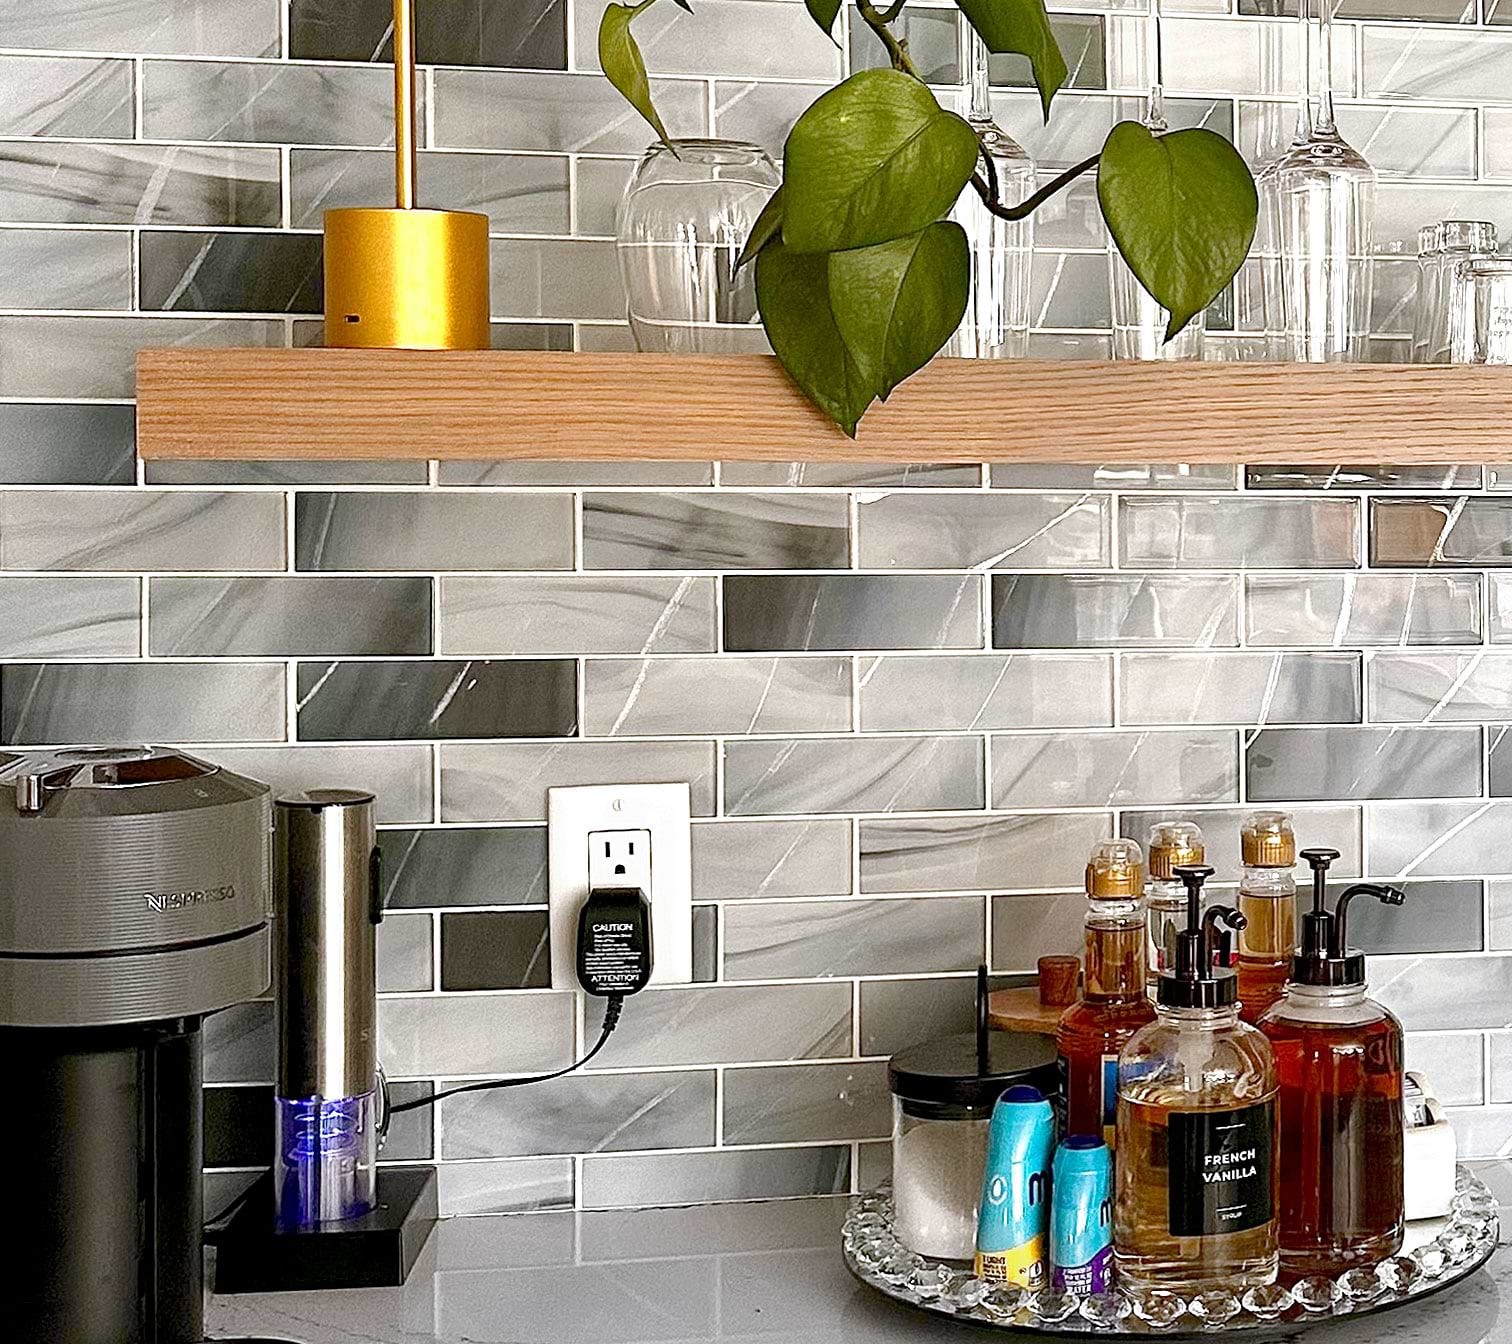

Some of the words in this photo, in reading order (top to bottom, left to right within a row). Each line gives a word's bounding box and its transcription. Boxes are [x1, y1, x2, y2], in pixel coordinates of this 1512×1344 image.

[592, 923, 634, 933] CAUTION
[590, 974, 640, 983] ATTENTION
[1204, 1148, 1256, 1166] FRENCH
[1201, 1165, 1257, 1183] VANILLA
